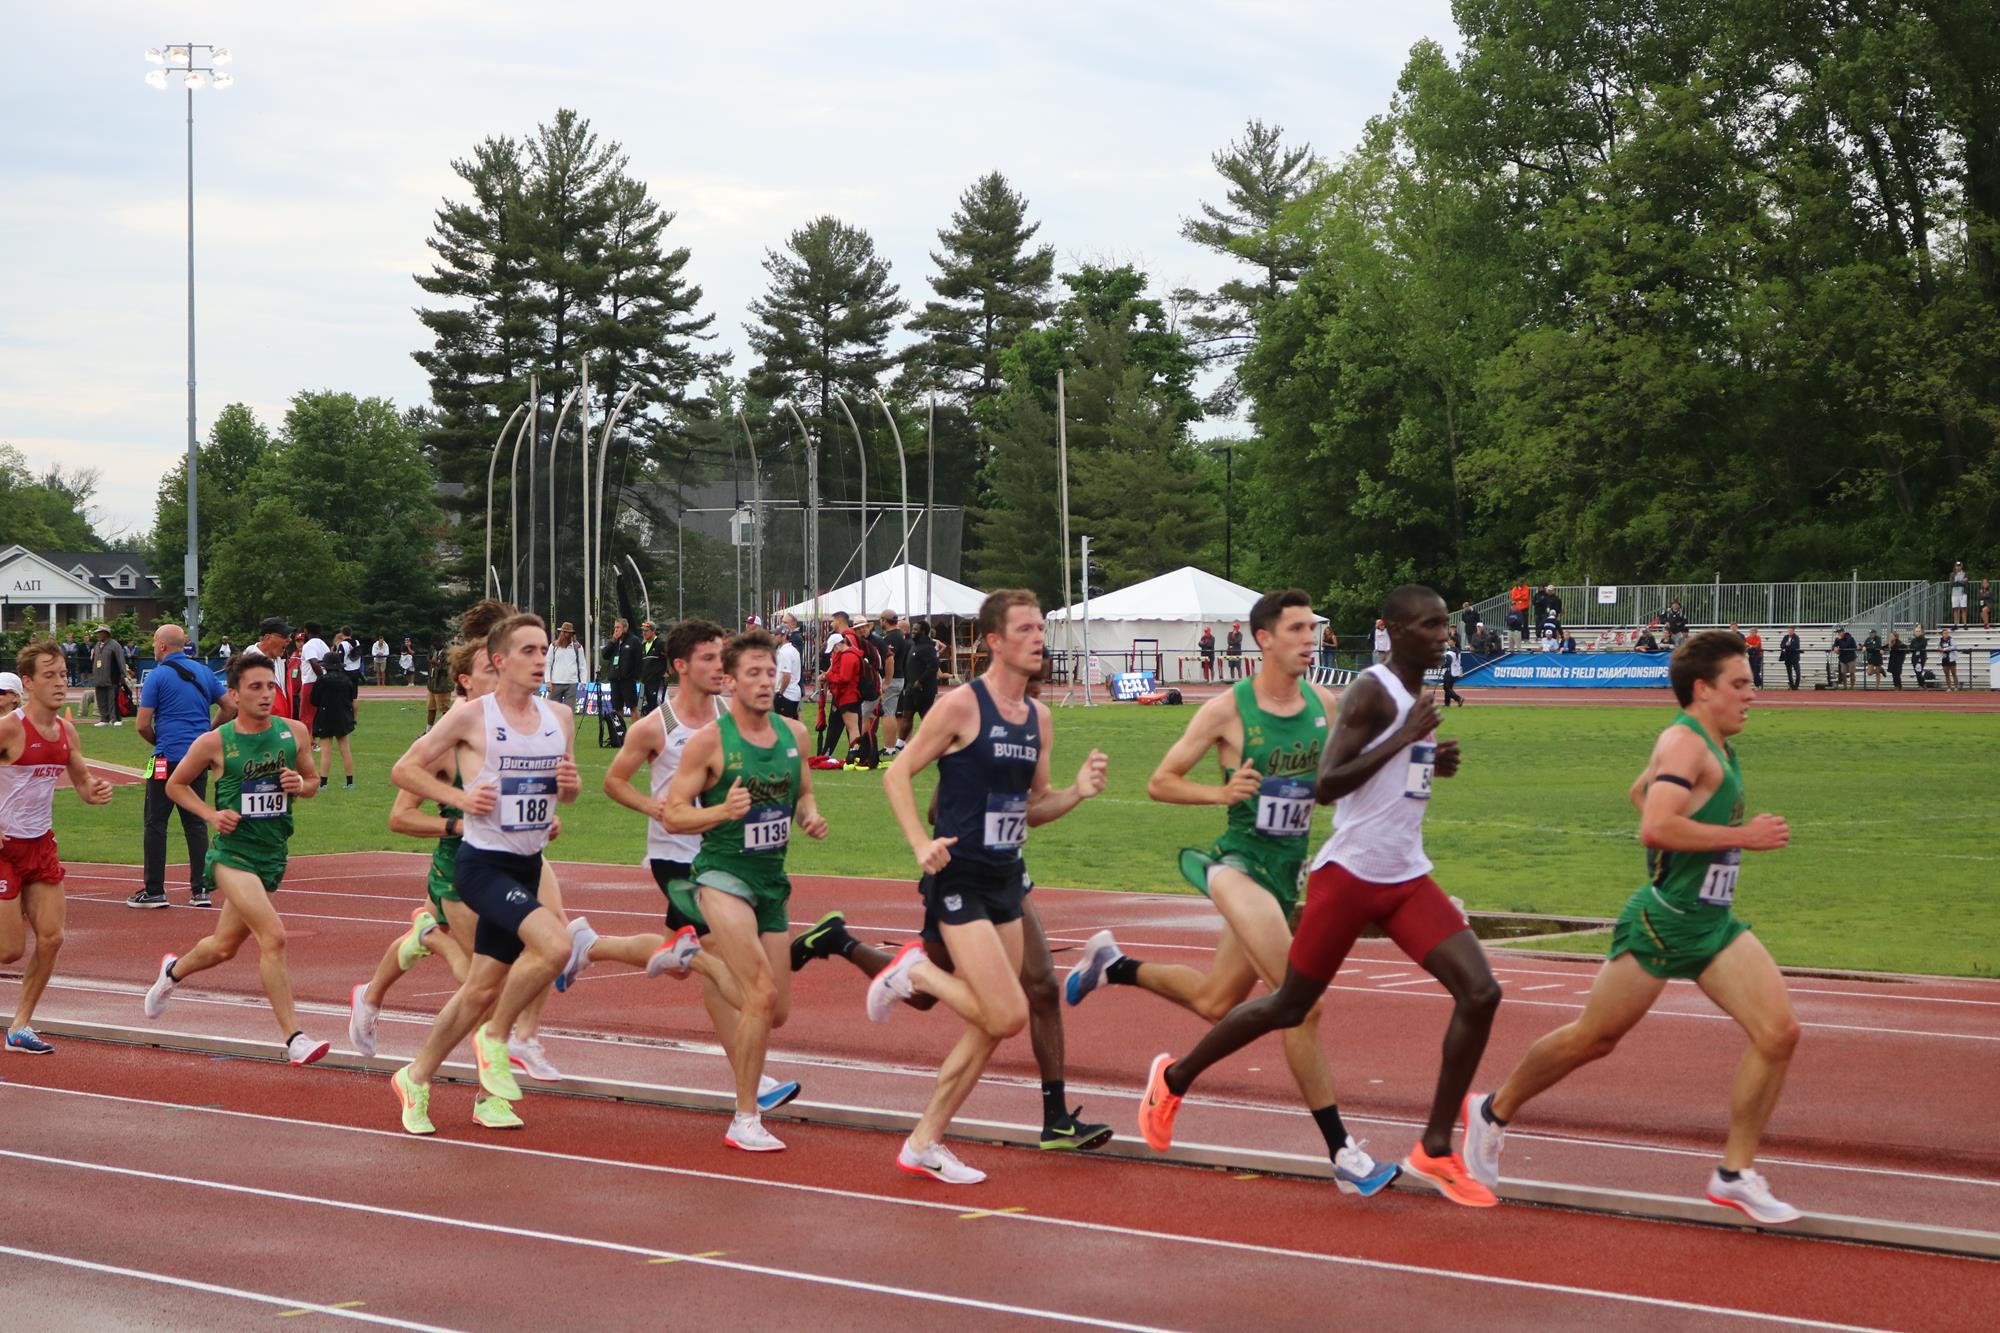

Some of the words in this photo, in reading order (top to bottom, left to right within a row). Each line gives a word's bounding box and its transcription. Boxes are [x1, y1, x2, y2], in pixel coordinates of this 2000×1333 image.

[1494, 667, 1534, 678] OUTDOOR
[1536, 667, 1562, 678] TRACK
[1562, 667, 1570, 678] &
[1571, 667, 1596, 678] FIELD
[1596, 666, 1669, 678] CHAMPIONSHIPS
[496, 727, 507, 741] S
[994, 743, 1037, 761] BUTLER
[502, 757, 561, 770] BUCCANEER
[248, 795, 284, 813] 1149
[515, 799, 548, 822] 188
[752, 821, 788, 845] 1139
